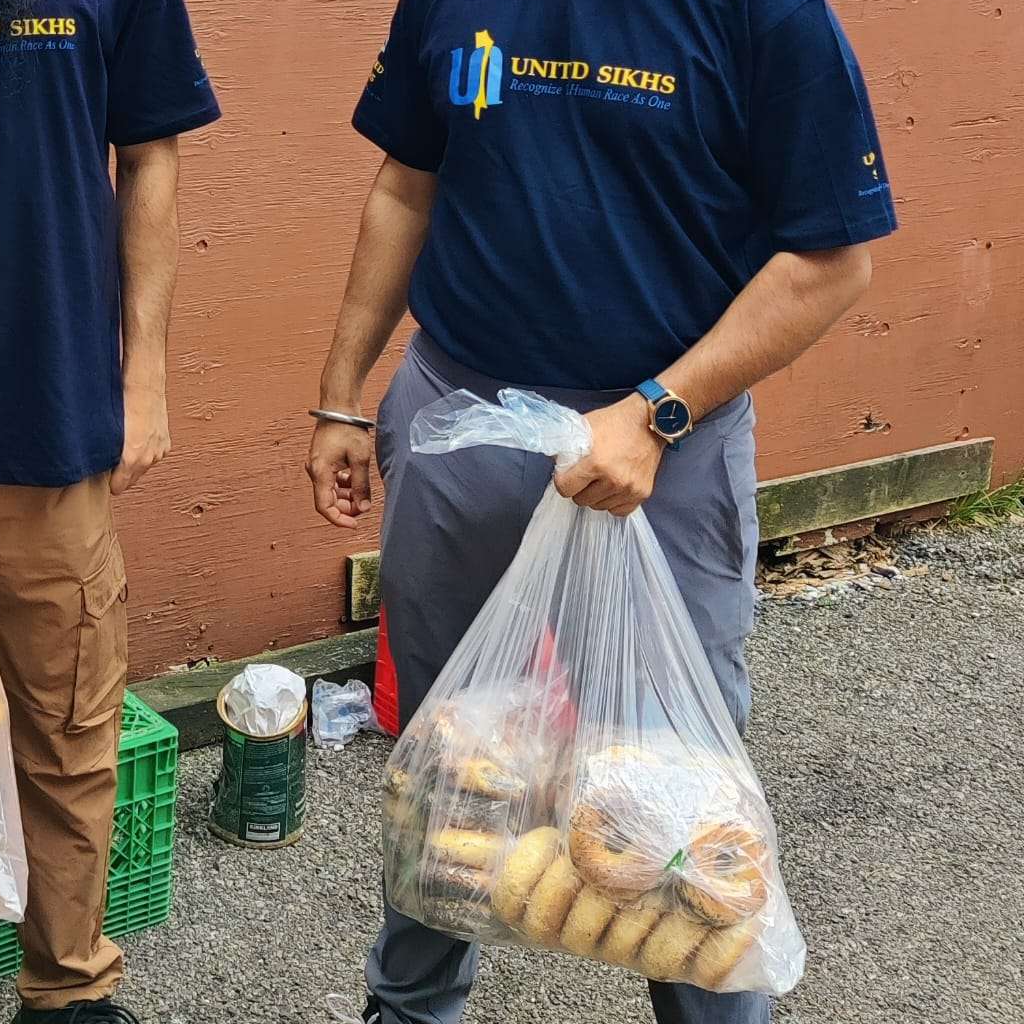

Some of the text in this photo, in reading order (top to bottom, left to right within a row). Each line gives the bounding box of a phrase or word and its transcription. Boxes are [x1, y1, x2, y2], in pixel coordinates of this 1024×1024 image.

[10, 17, 76, 36] SIKHS
[45, 39, 56, 50] As
[59, 38, 75, 50] One
[511, 56, 590, 80] UNITD
[596, 65, 676, 94] SIKHS
[509, 78, 563, 96] Recognize
[569, 83, 602, 99] Human
[604, 88, 629, 103] Race
[630, 92, 645, 105] As
[647, 95, 671, 110] One
